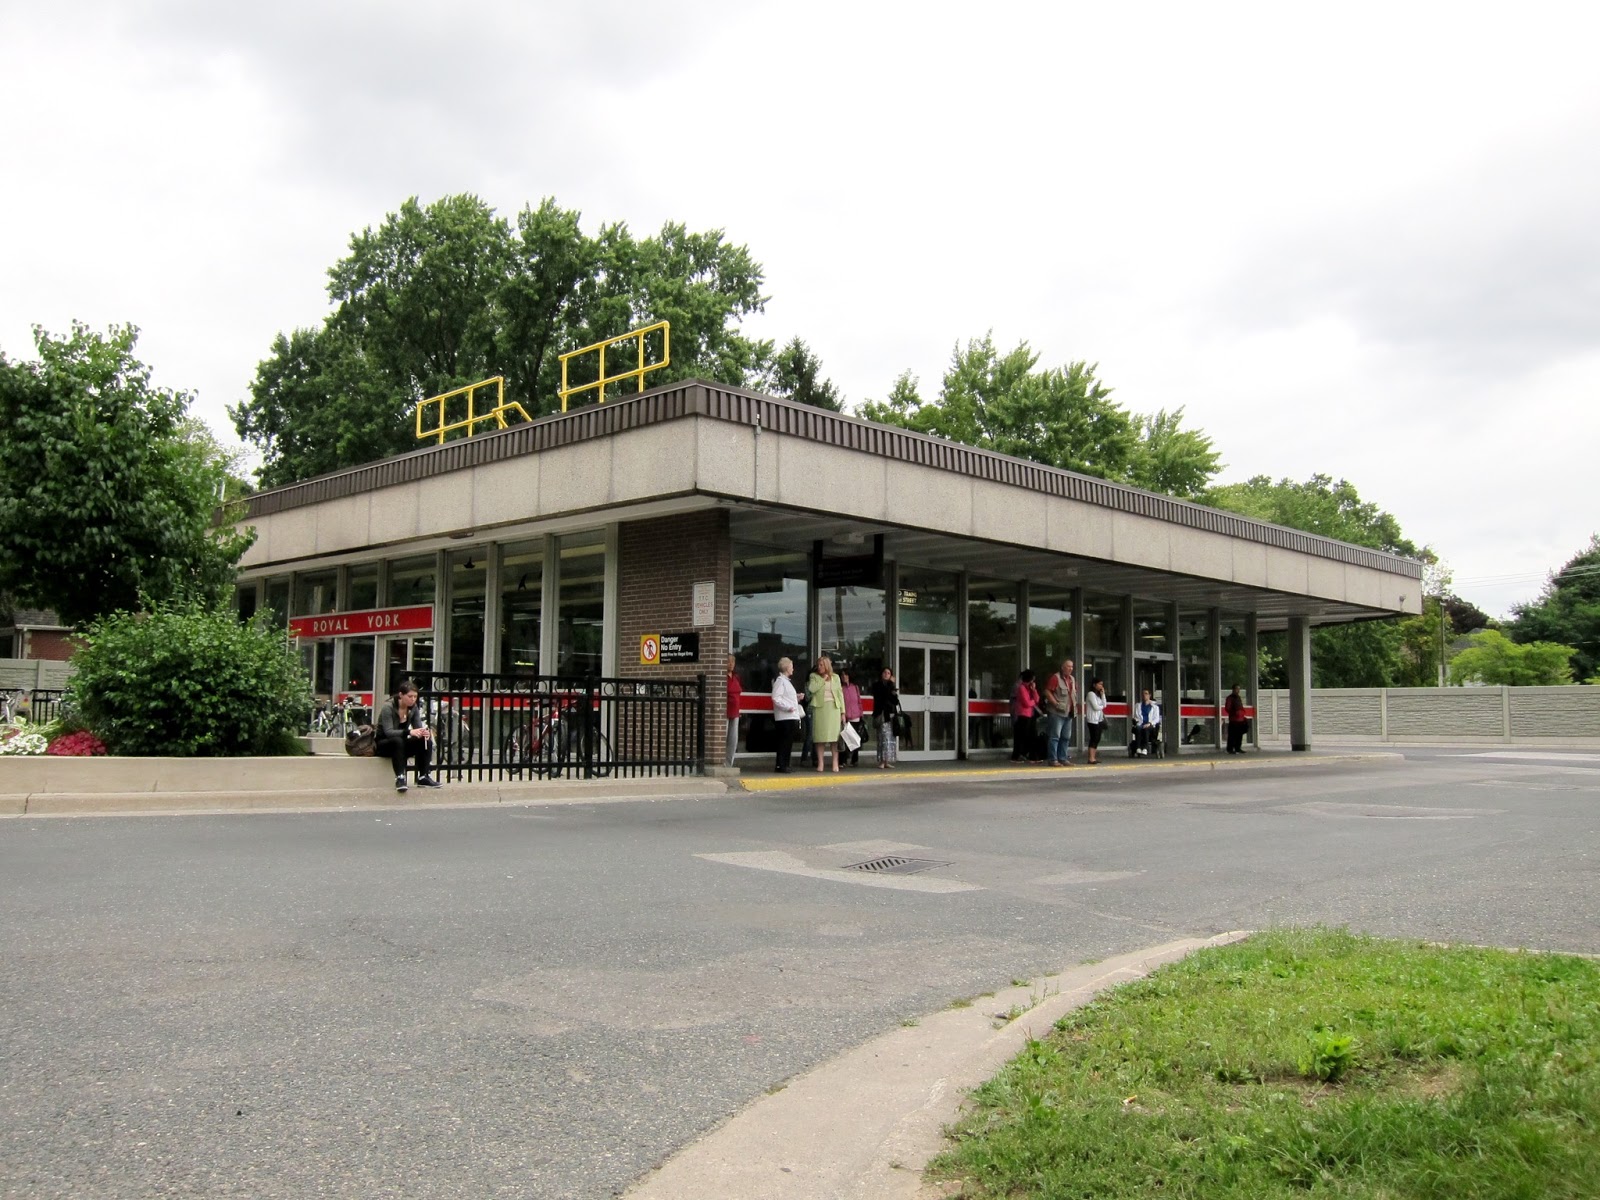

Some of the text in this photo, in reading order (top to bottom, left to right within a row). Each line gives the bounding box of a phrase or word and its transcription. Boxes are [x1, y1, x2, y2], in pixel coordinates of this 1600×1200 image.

[313, 614, 399, 632] ROYAL YORK
[661, 636, 678, 645] Danger
[669, 643, 682, 651] Entry
